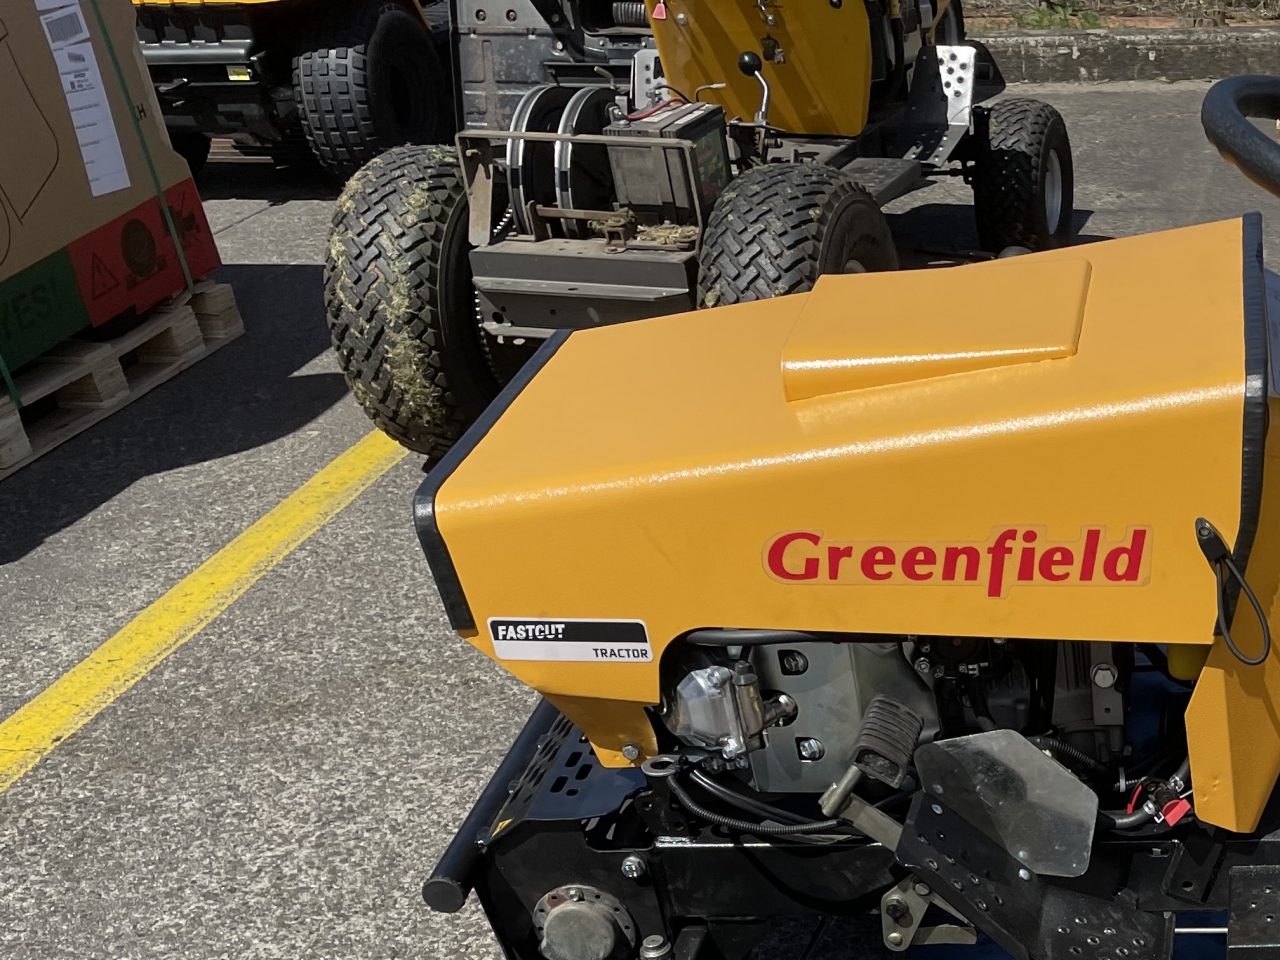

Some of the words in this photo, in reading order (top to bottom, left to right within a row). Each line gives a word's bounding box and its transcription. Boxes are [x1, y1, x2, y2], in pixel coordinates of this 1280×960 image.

[767, 528, 1147, 598] Greenfield
[498, 623, 565, 640] FASTCUT
[593, 648, 649, 659] TRACTOR
